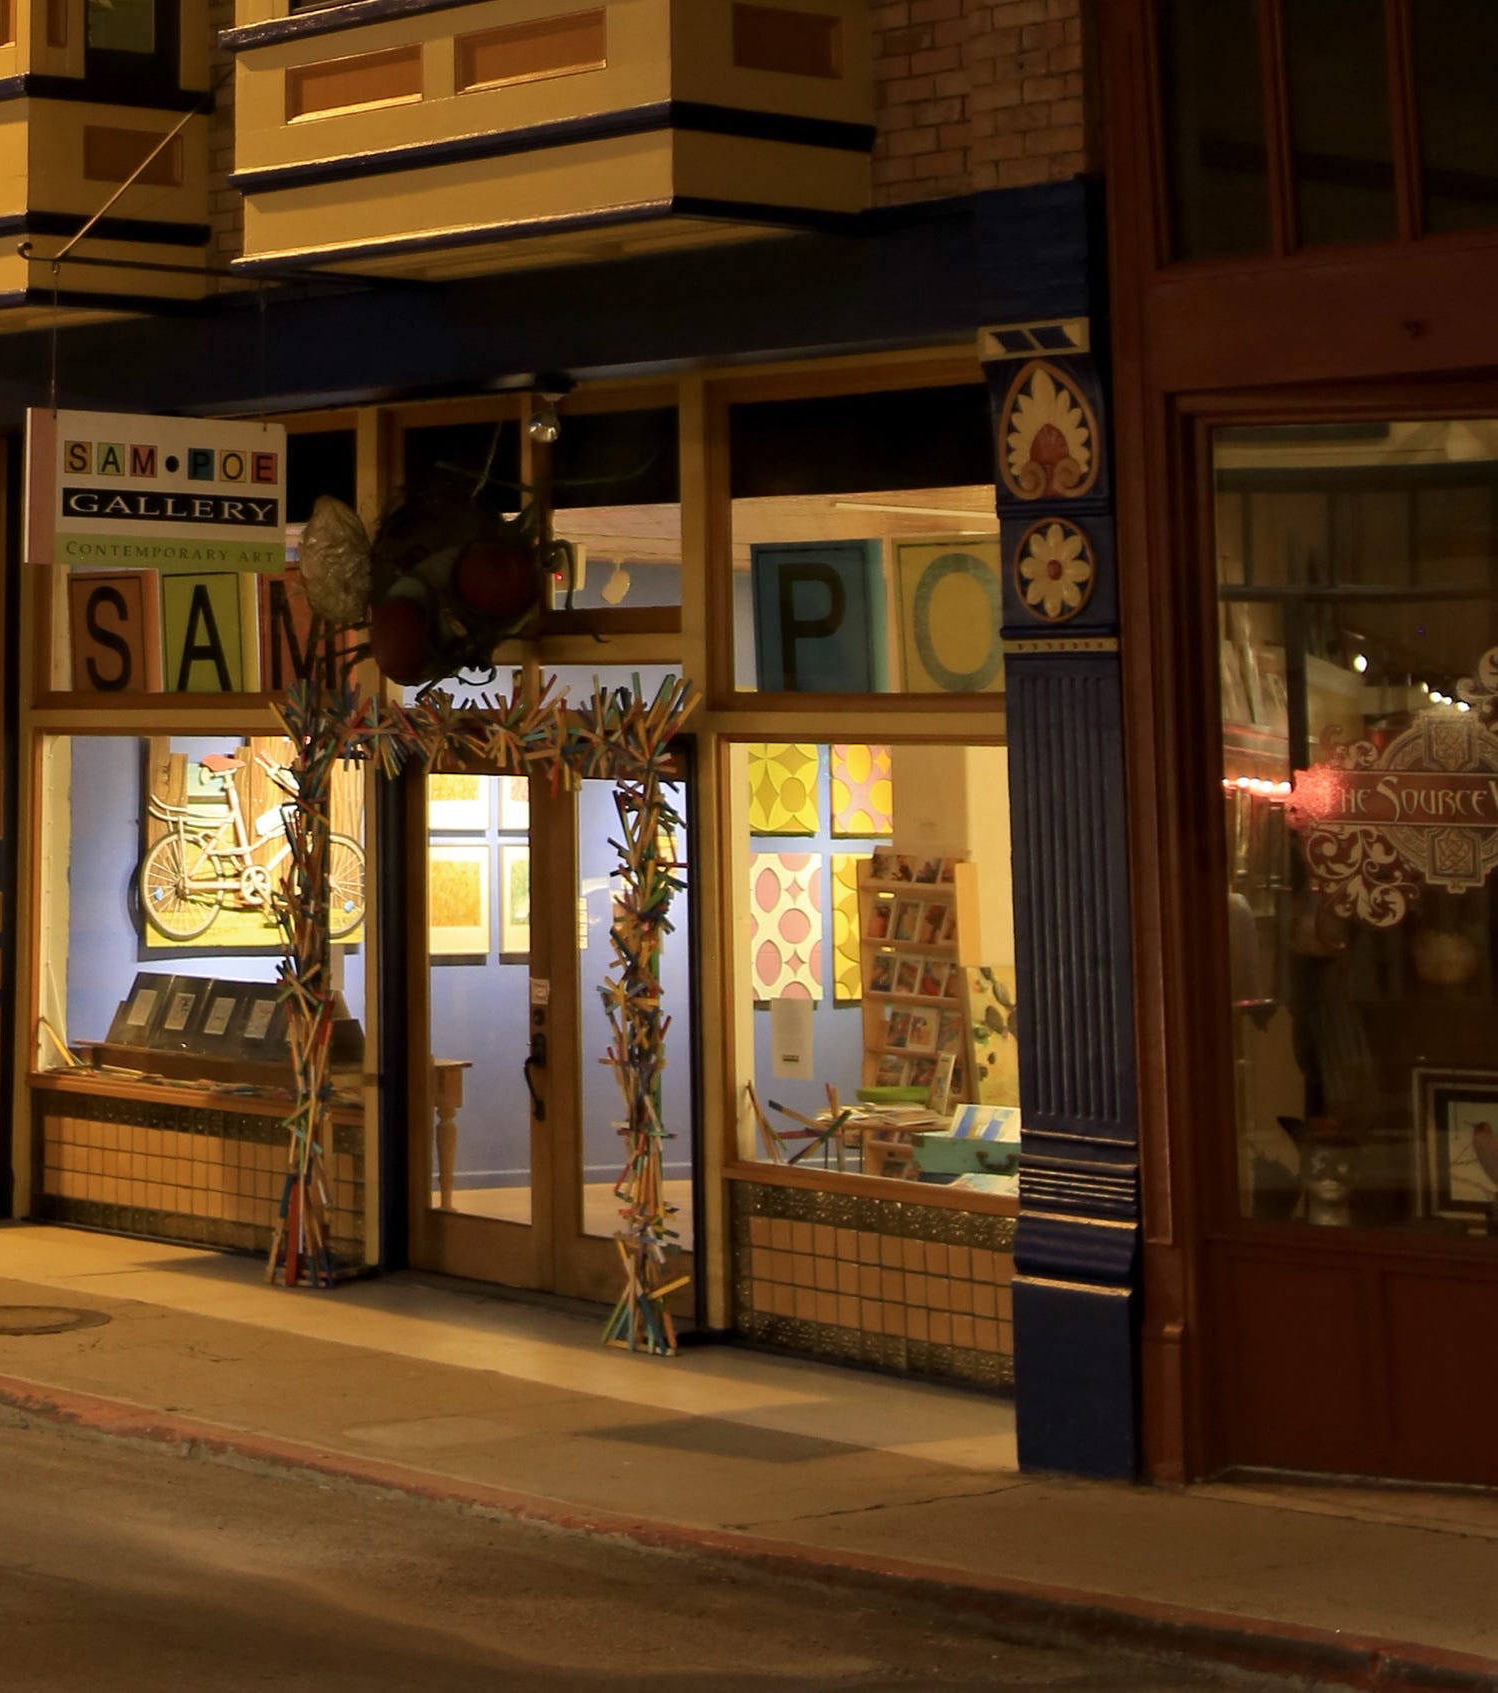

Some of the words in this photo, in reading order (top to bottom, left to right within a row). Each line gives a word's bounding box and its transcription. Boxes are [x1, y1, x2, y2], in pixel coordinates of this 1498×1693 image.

[68, 443, 155, 474] SAM
[192, 451, 273, 482] POE
[69, 494, 274, 521] GALLERY
[66, 540, 229, 561] CONTEMPORARY
[238, 550, 274, 563] ART
[85, 579, 336, 692] SAM
[1377, 776, 1486, 823] SOURCE
